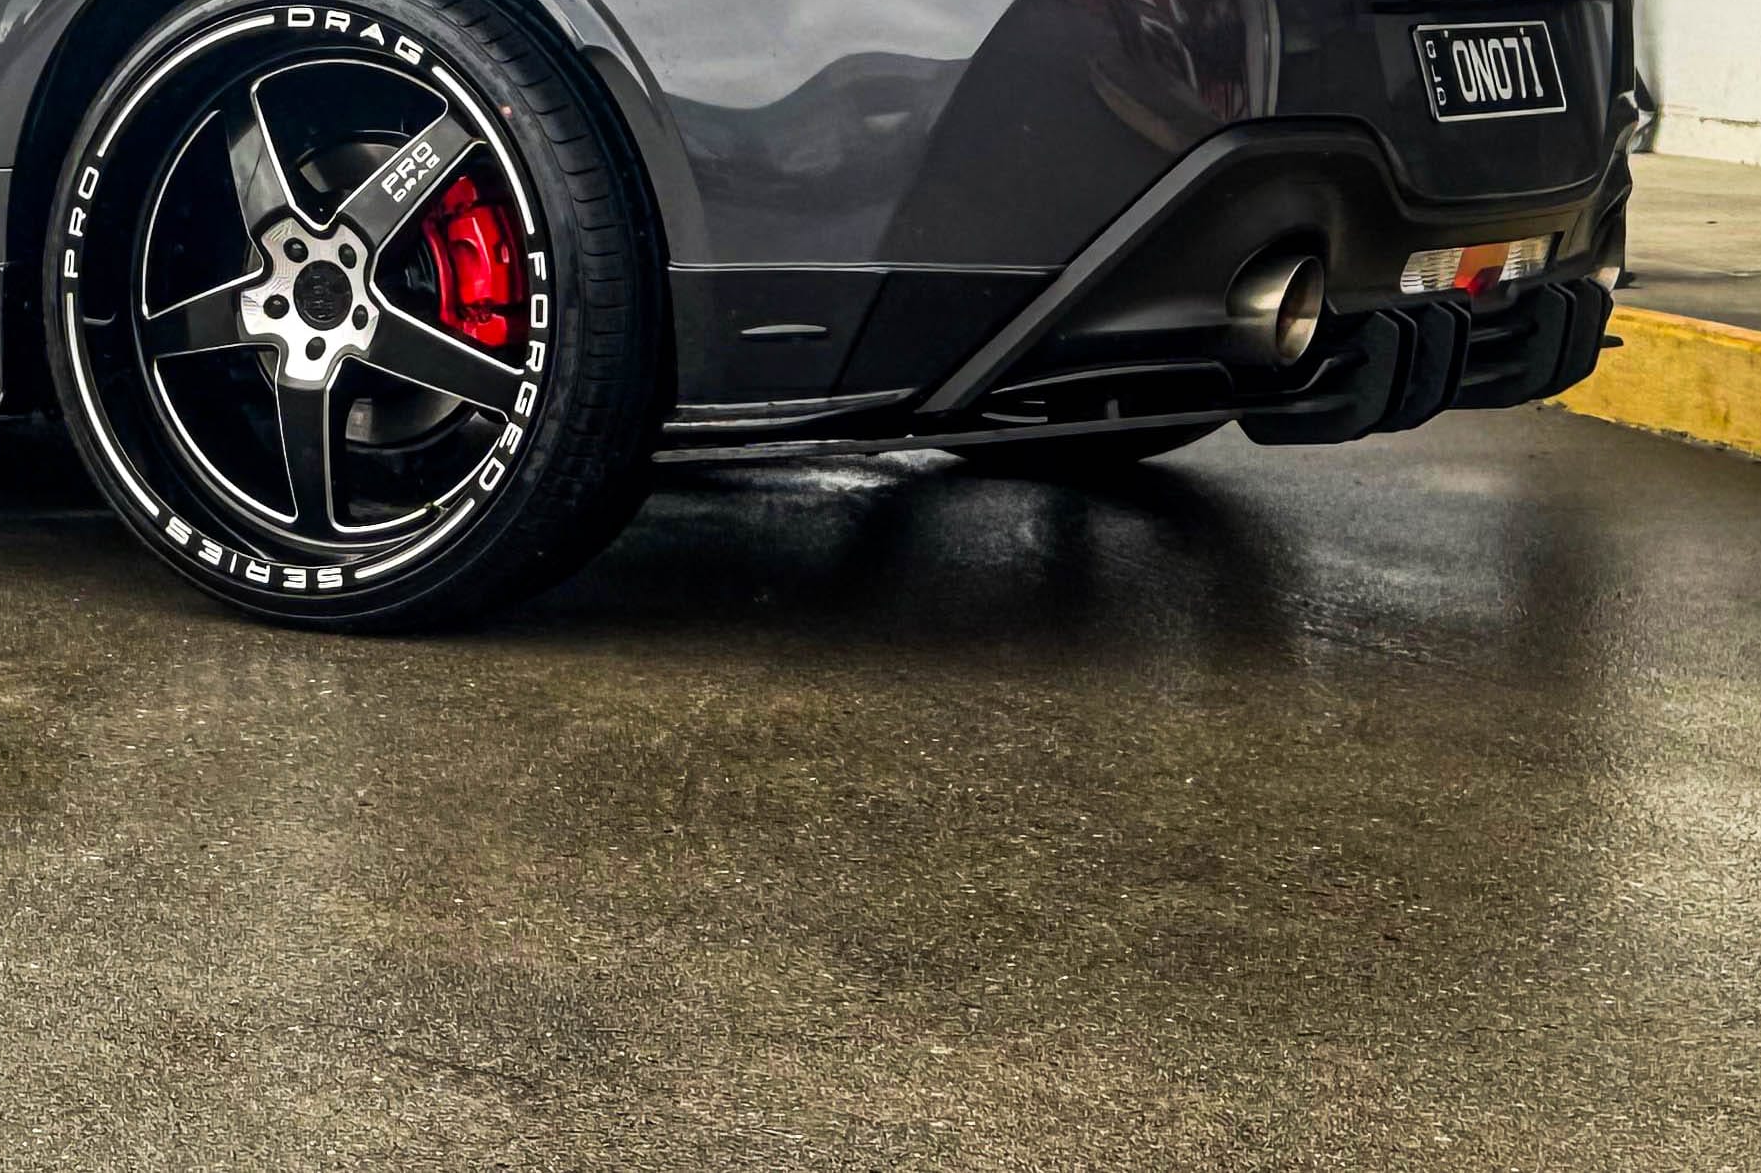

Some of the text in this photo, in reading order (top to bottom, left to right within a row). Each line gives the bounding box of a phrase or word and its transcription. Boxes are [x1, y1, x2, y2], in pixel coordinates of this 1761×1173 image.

[381, 141, 433, 195] PRO
[392, 153, 441, 203] DRAG
[63, 7, 549, 590] PRO DRAG FORGED SERIES
